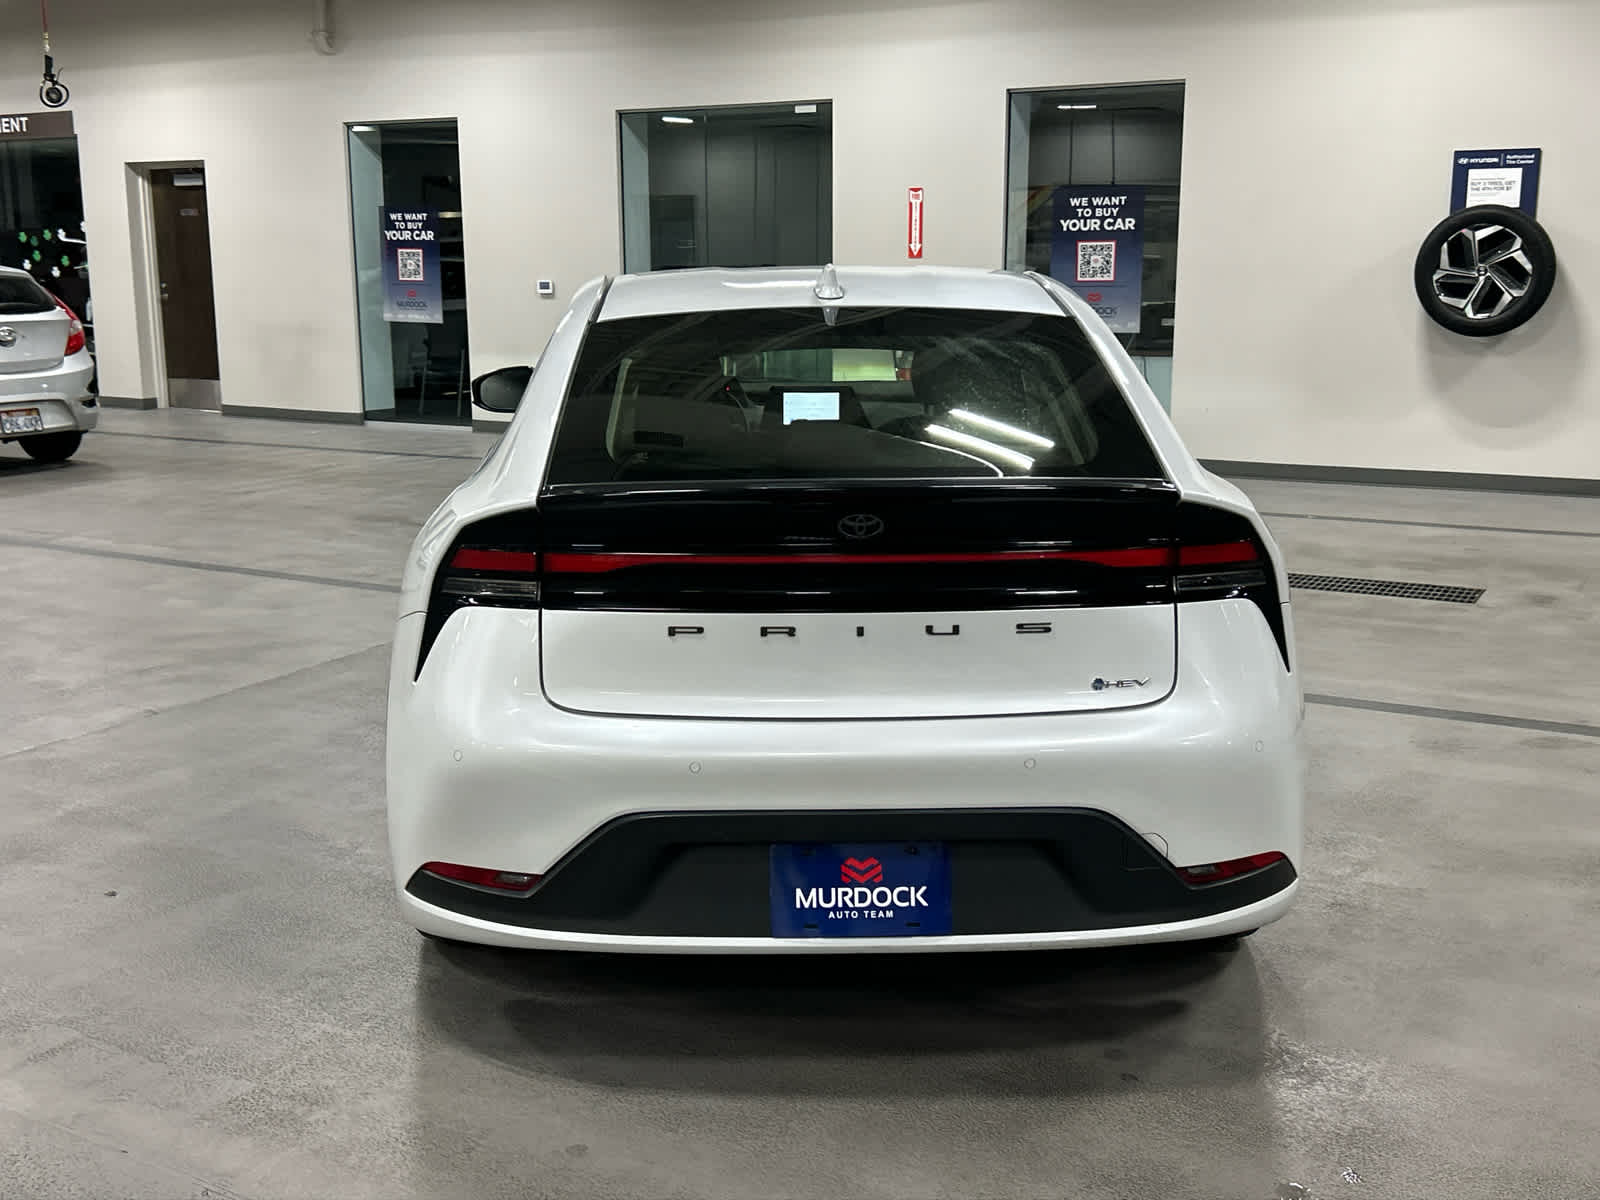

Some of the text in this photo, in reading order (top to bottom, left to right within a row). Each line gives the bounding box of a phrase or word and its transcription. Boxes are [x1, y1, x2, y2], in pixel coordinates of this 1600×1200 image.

[0, 117, 28, 133] ENT
[1069, 196, 1127, 207] WE WANT
[389, 212, 427, 220] WE WANT
[1076, 207, 1119, 217] TO BUY
[394, 221, 423, 229] TO BUY
[1060, 218, 1136, 231] YOUR CAR
[384, 230, 434, 240] YOUR CAR
[668, 622, 1052, 637] PRIUS
[1104, 678, 1150, 688] HEV
[795, 886, 929, 909] MURDOCK
[828, 910, 894, 919] AUTO TEAM
